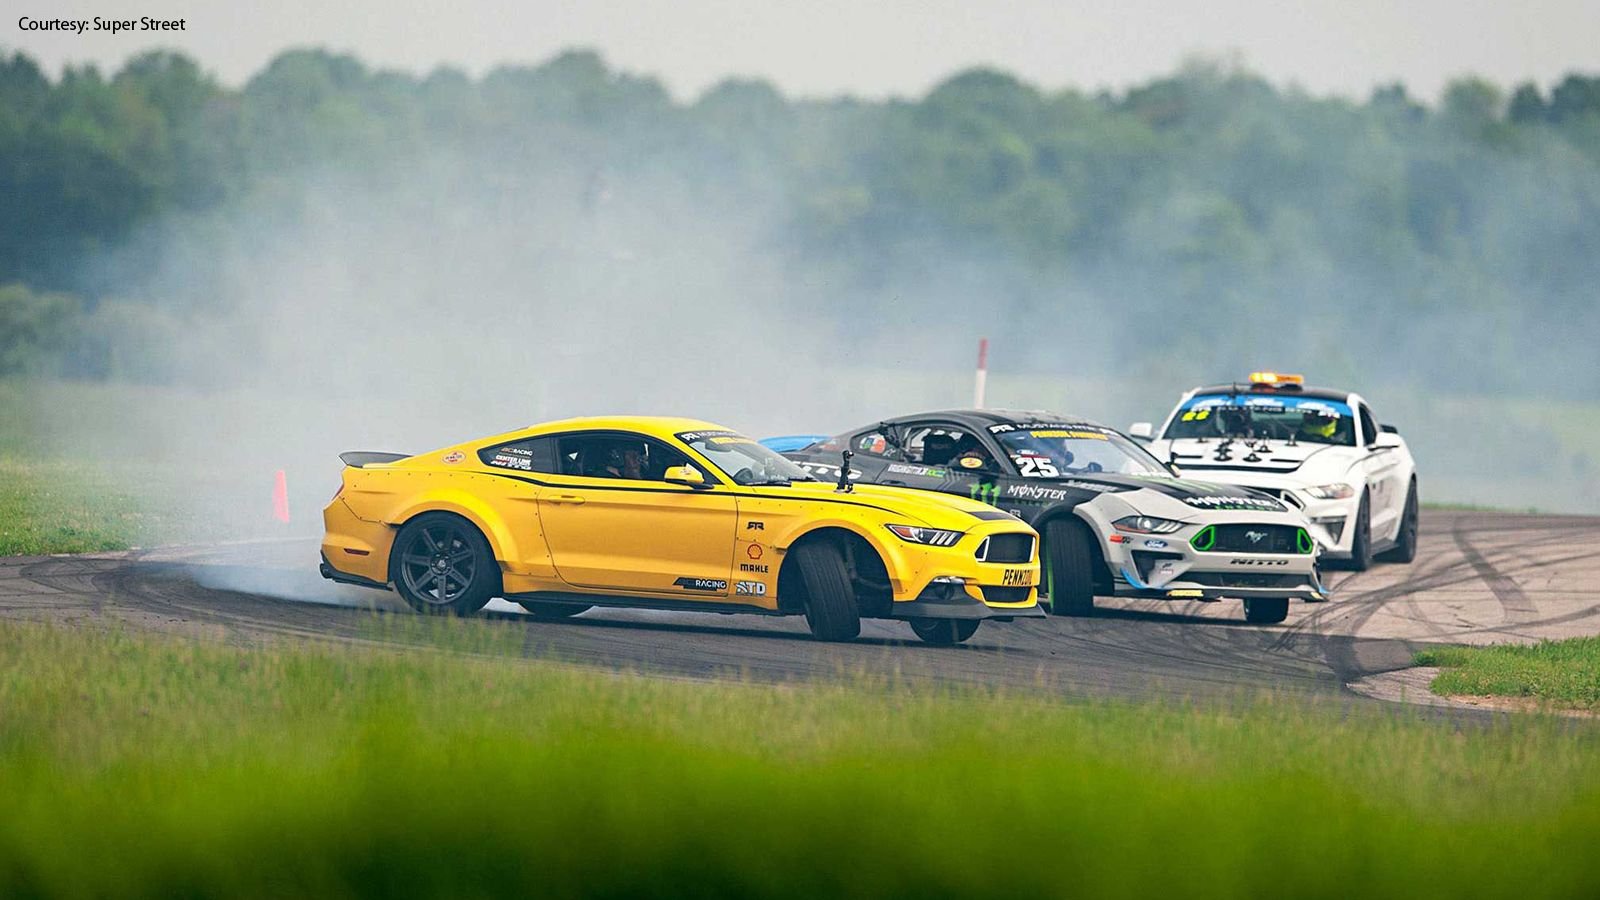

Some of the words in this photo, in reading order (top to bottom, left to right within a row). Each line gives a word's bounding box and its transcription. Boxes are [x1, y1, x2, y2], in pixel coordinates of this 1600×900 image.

[1015, 457, 1060, 478] 25
[1231, 558, 1289, 566] NITTO
[740, 563, 769, 574] MAHLE
[695, 579, 726, 588] RACING
